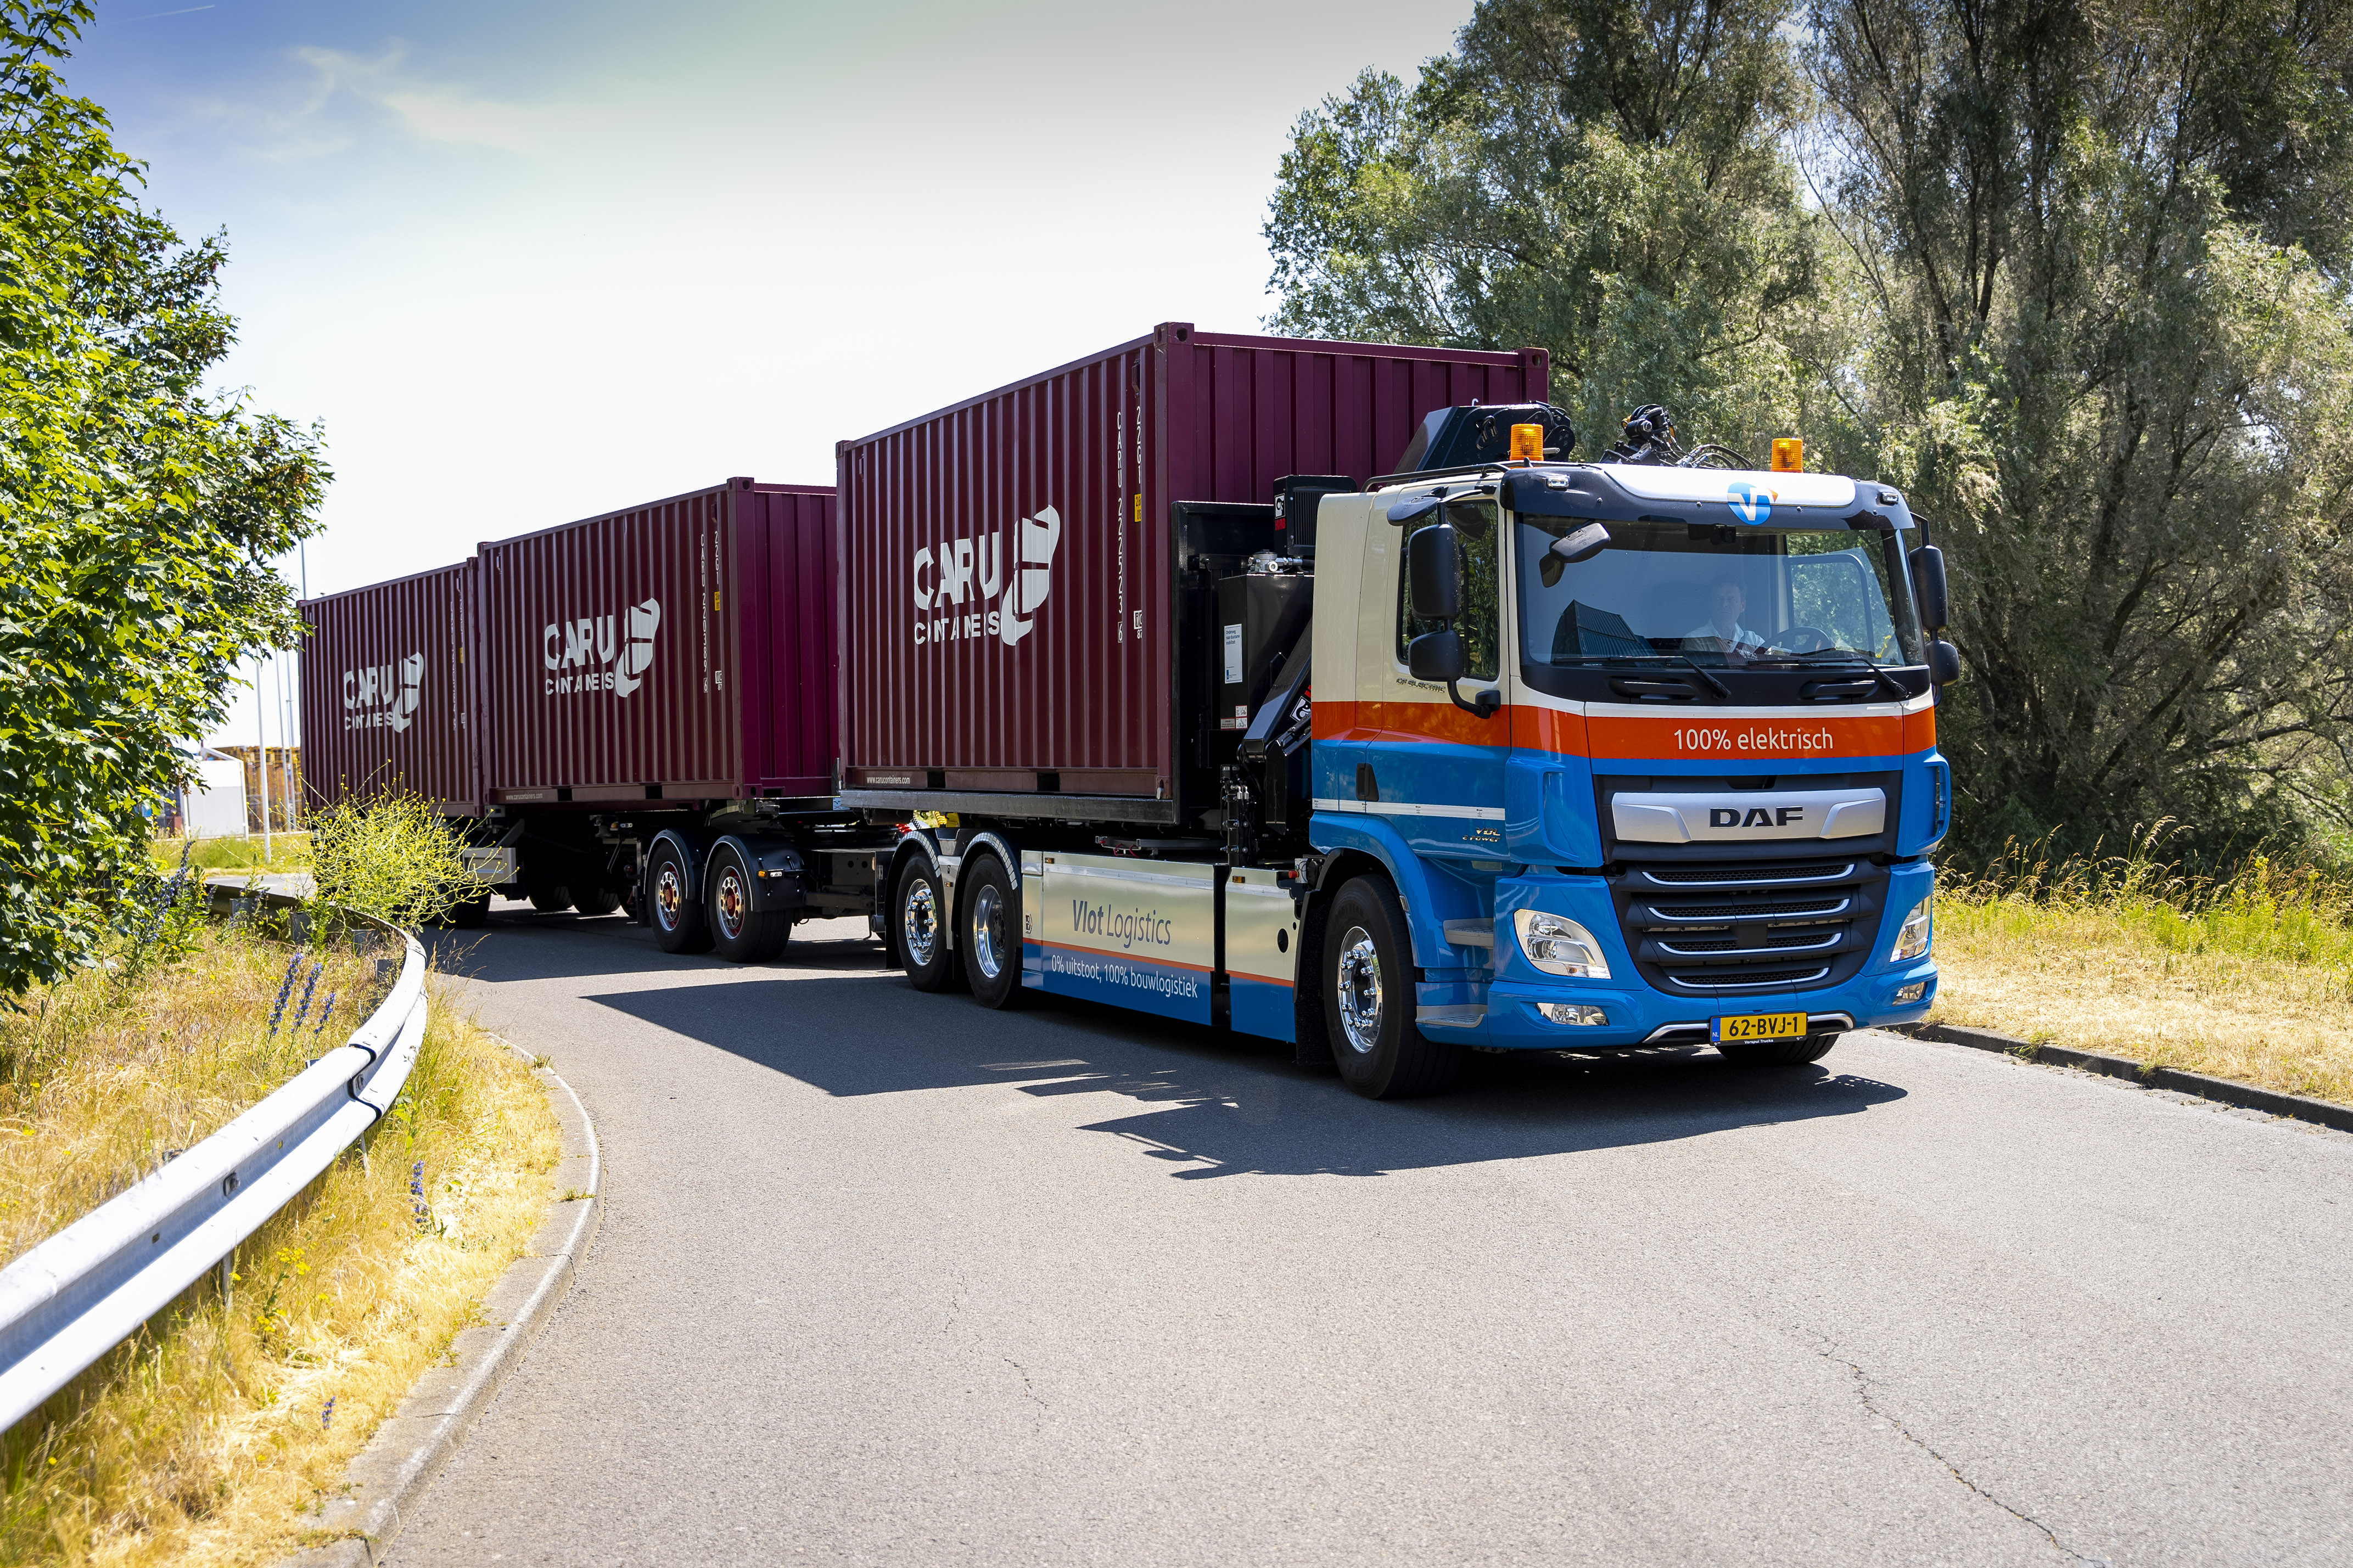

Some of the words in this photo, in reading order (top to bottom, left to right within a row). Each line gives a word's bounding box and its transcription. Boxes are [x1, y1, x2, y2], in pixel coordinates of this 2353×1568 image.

[1275, 518, 1286, 531] HIAB
[914, 532, 1000, 610] CARU
[914, 611, 1000, 644] CNTAINES
[1119, 622, 1123, 642] 6
[545, 615, 614, 670] CARU
[344, 665, 393, 709] CARU
[546, 672, 614, 695] CNTAINES
[1408, 679, 1446, 693] ELECTRIC
[345, 711, 393, 730] CNTAINES
[1674, 729, 1732, 750] 100%
[1738, 727, 1833, 750] elektrisch
[866, 775, 910, 784] www.carucontainers.com
[1710, 806, 1803, 828] DAF
[1476, 827, 1501, 836] VDL
[1073, 900, 1104, 935] Vlot
[1106, 904, 1171, 949] Logistics
[1051, 954, 1064, 974] 0%
[1066, 957, 1102, 983] uitstoot,
[1105, 964, 1128, 985] 100%
[1130, 966, 1198, 998] bouwlogistiek
[1729, 1016, 1798, 1037] 62-BVJ-1
